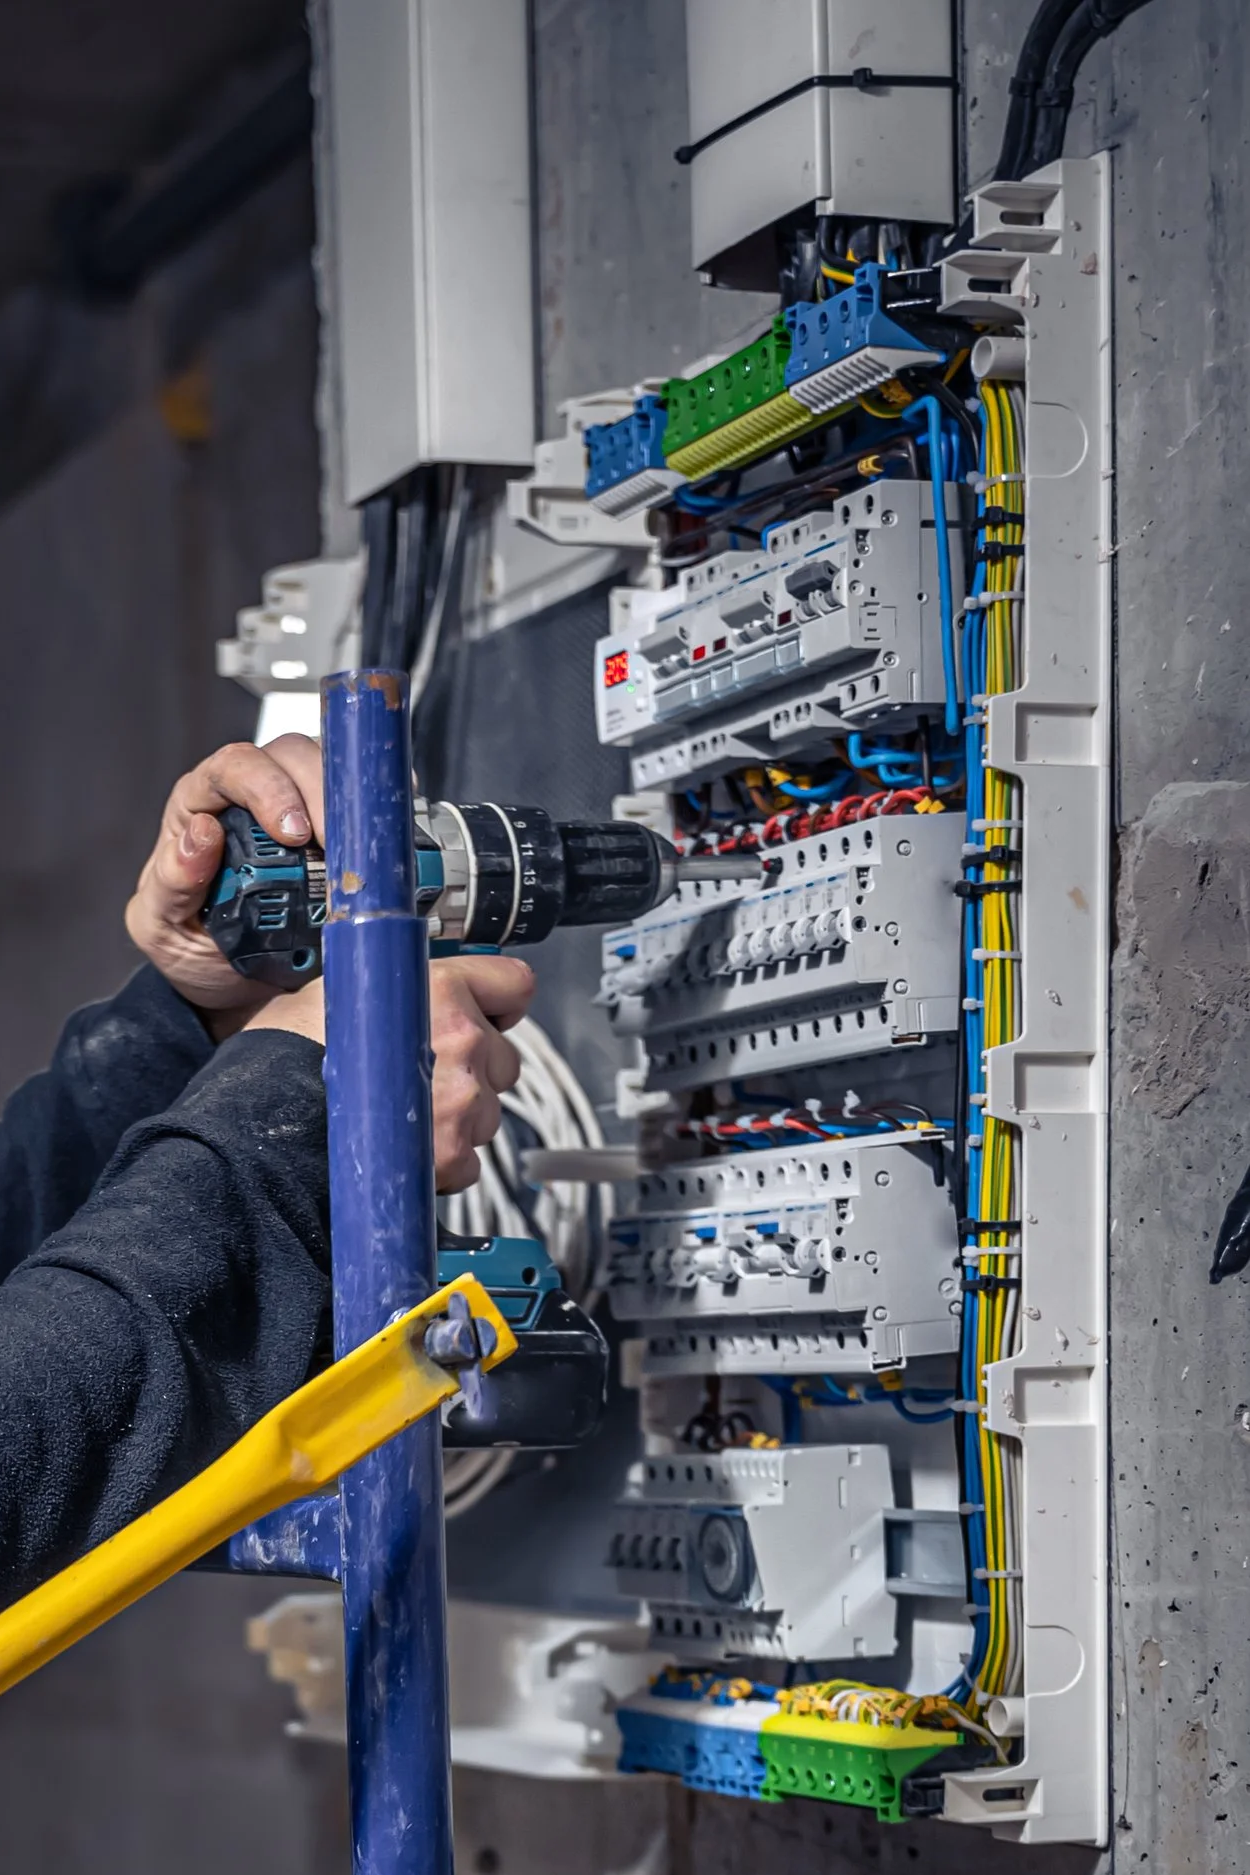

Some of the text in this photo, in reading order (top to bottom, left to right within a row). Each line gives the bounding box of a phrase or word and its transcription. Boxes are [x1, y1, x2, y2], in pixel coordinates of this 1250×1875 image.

[520, 842, 534, 856] 11
[523, 868, 536, 885] 13
[520, 898, 534, 912] 15
[514, 923, 528, 934] 17
